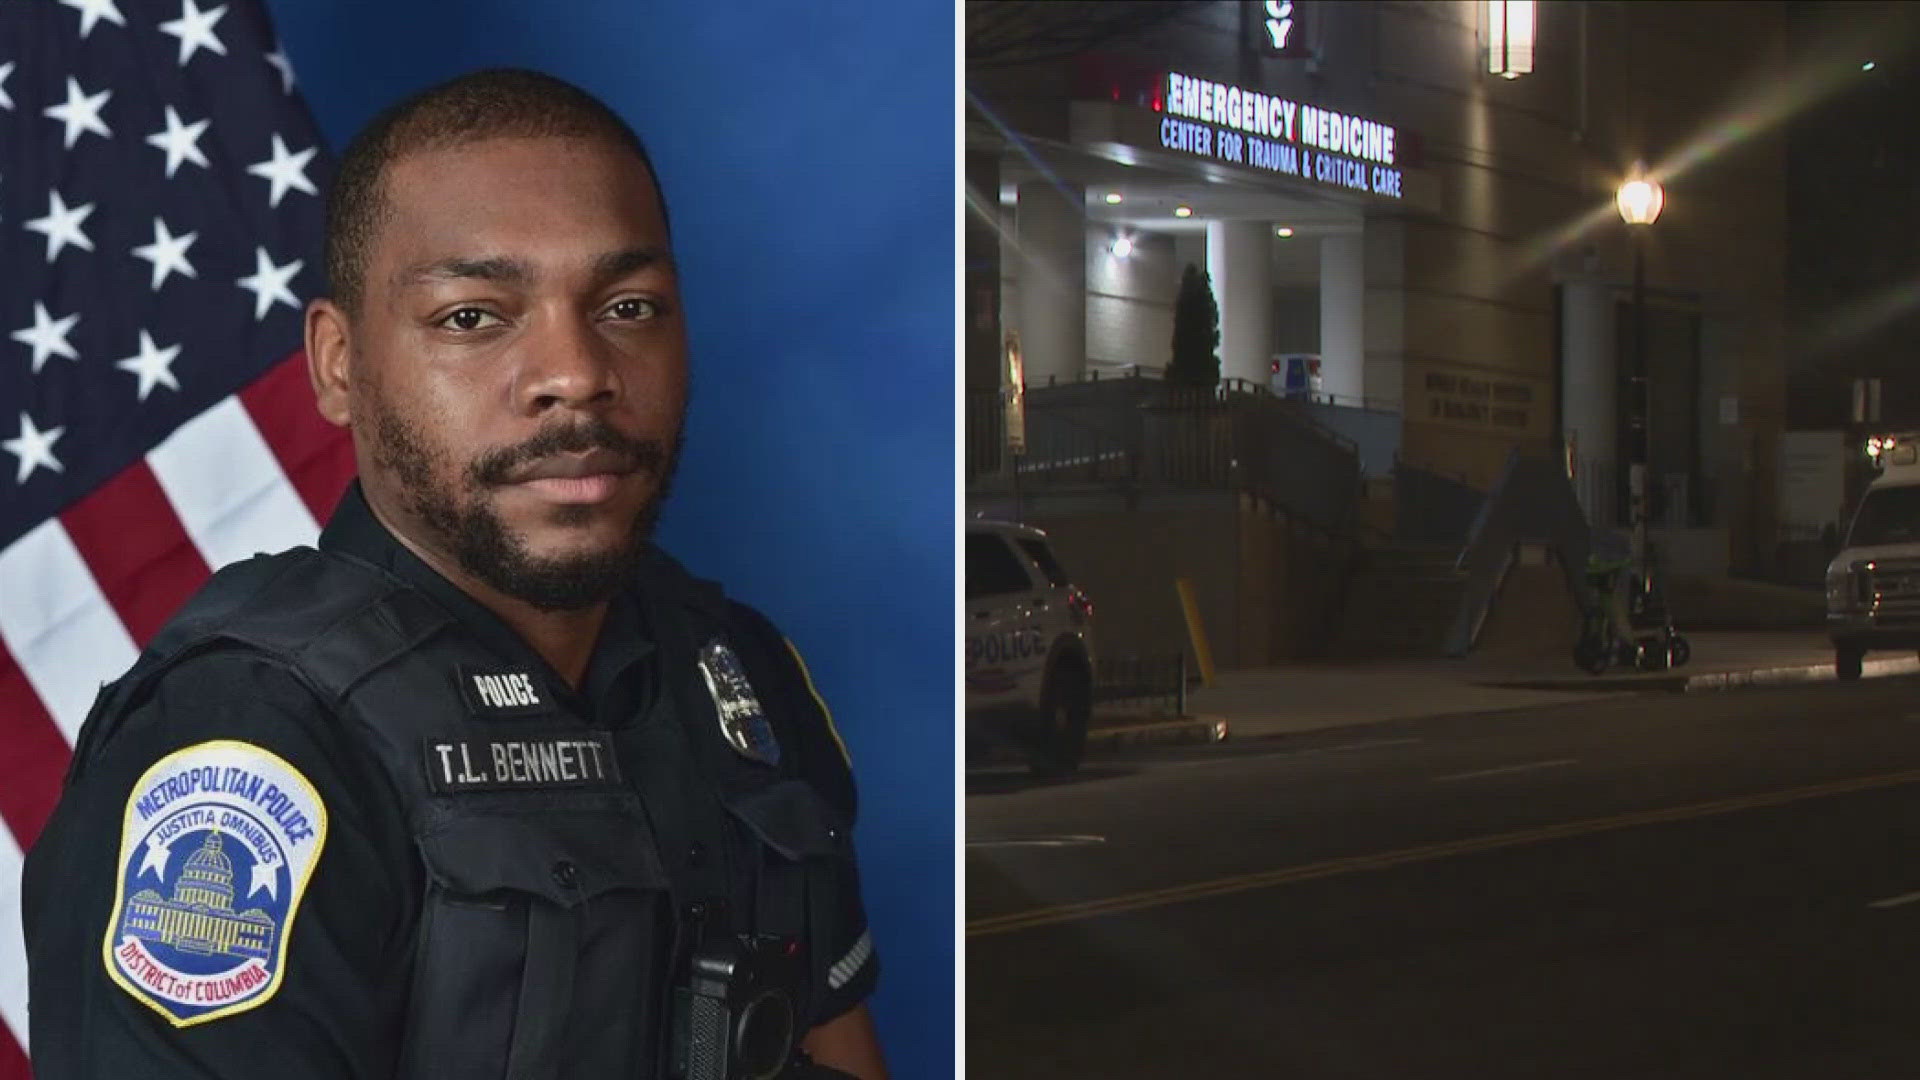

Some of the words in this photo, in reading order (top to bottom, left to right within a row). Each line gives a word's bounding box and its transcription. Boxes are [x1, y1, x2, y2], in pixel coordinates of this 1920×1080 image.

[1167, 72, 1297, 141] EMERGENCY
[1301, 105, 1396, 164] MEDICINE
[1160, 118, 1213, 156] CENTER
[1217, 131, 1244, 163] FOR
[1248, 138, 1299, 175] TRAUMA
[1302, 151, 1312, 178] &
[1315, 153, 1369, 191] CRITICAL
[1372, 166, 1402, 198] CARE
[971, 631, 1046, 665] POLICE
[473, 674, 539, 707] POLICE
[436, 743, 487, 783] T.L.
[491, 741, 605, 782] BENNETT
[136, 766, 263, 820] METROPOLITAN
[258, 784, 313, 845] POLICE
[157, 810, 215, 845] JUSTITIA
[220, 812, 278, 863] OMNIBUS
[119, 942, 176, 994] DISTRICT
[175, 983, 192, 1000] of
[195, 964, 269, 1001] COLUMBIA
